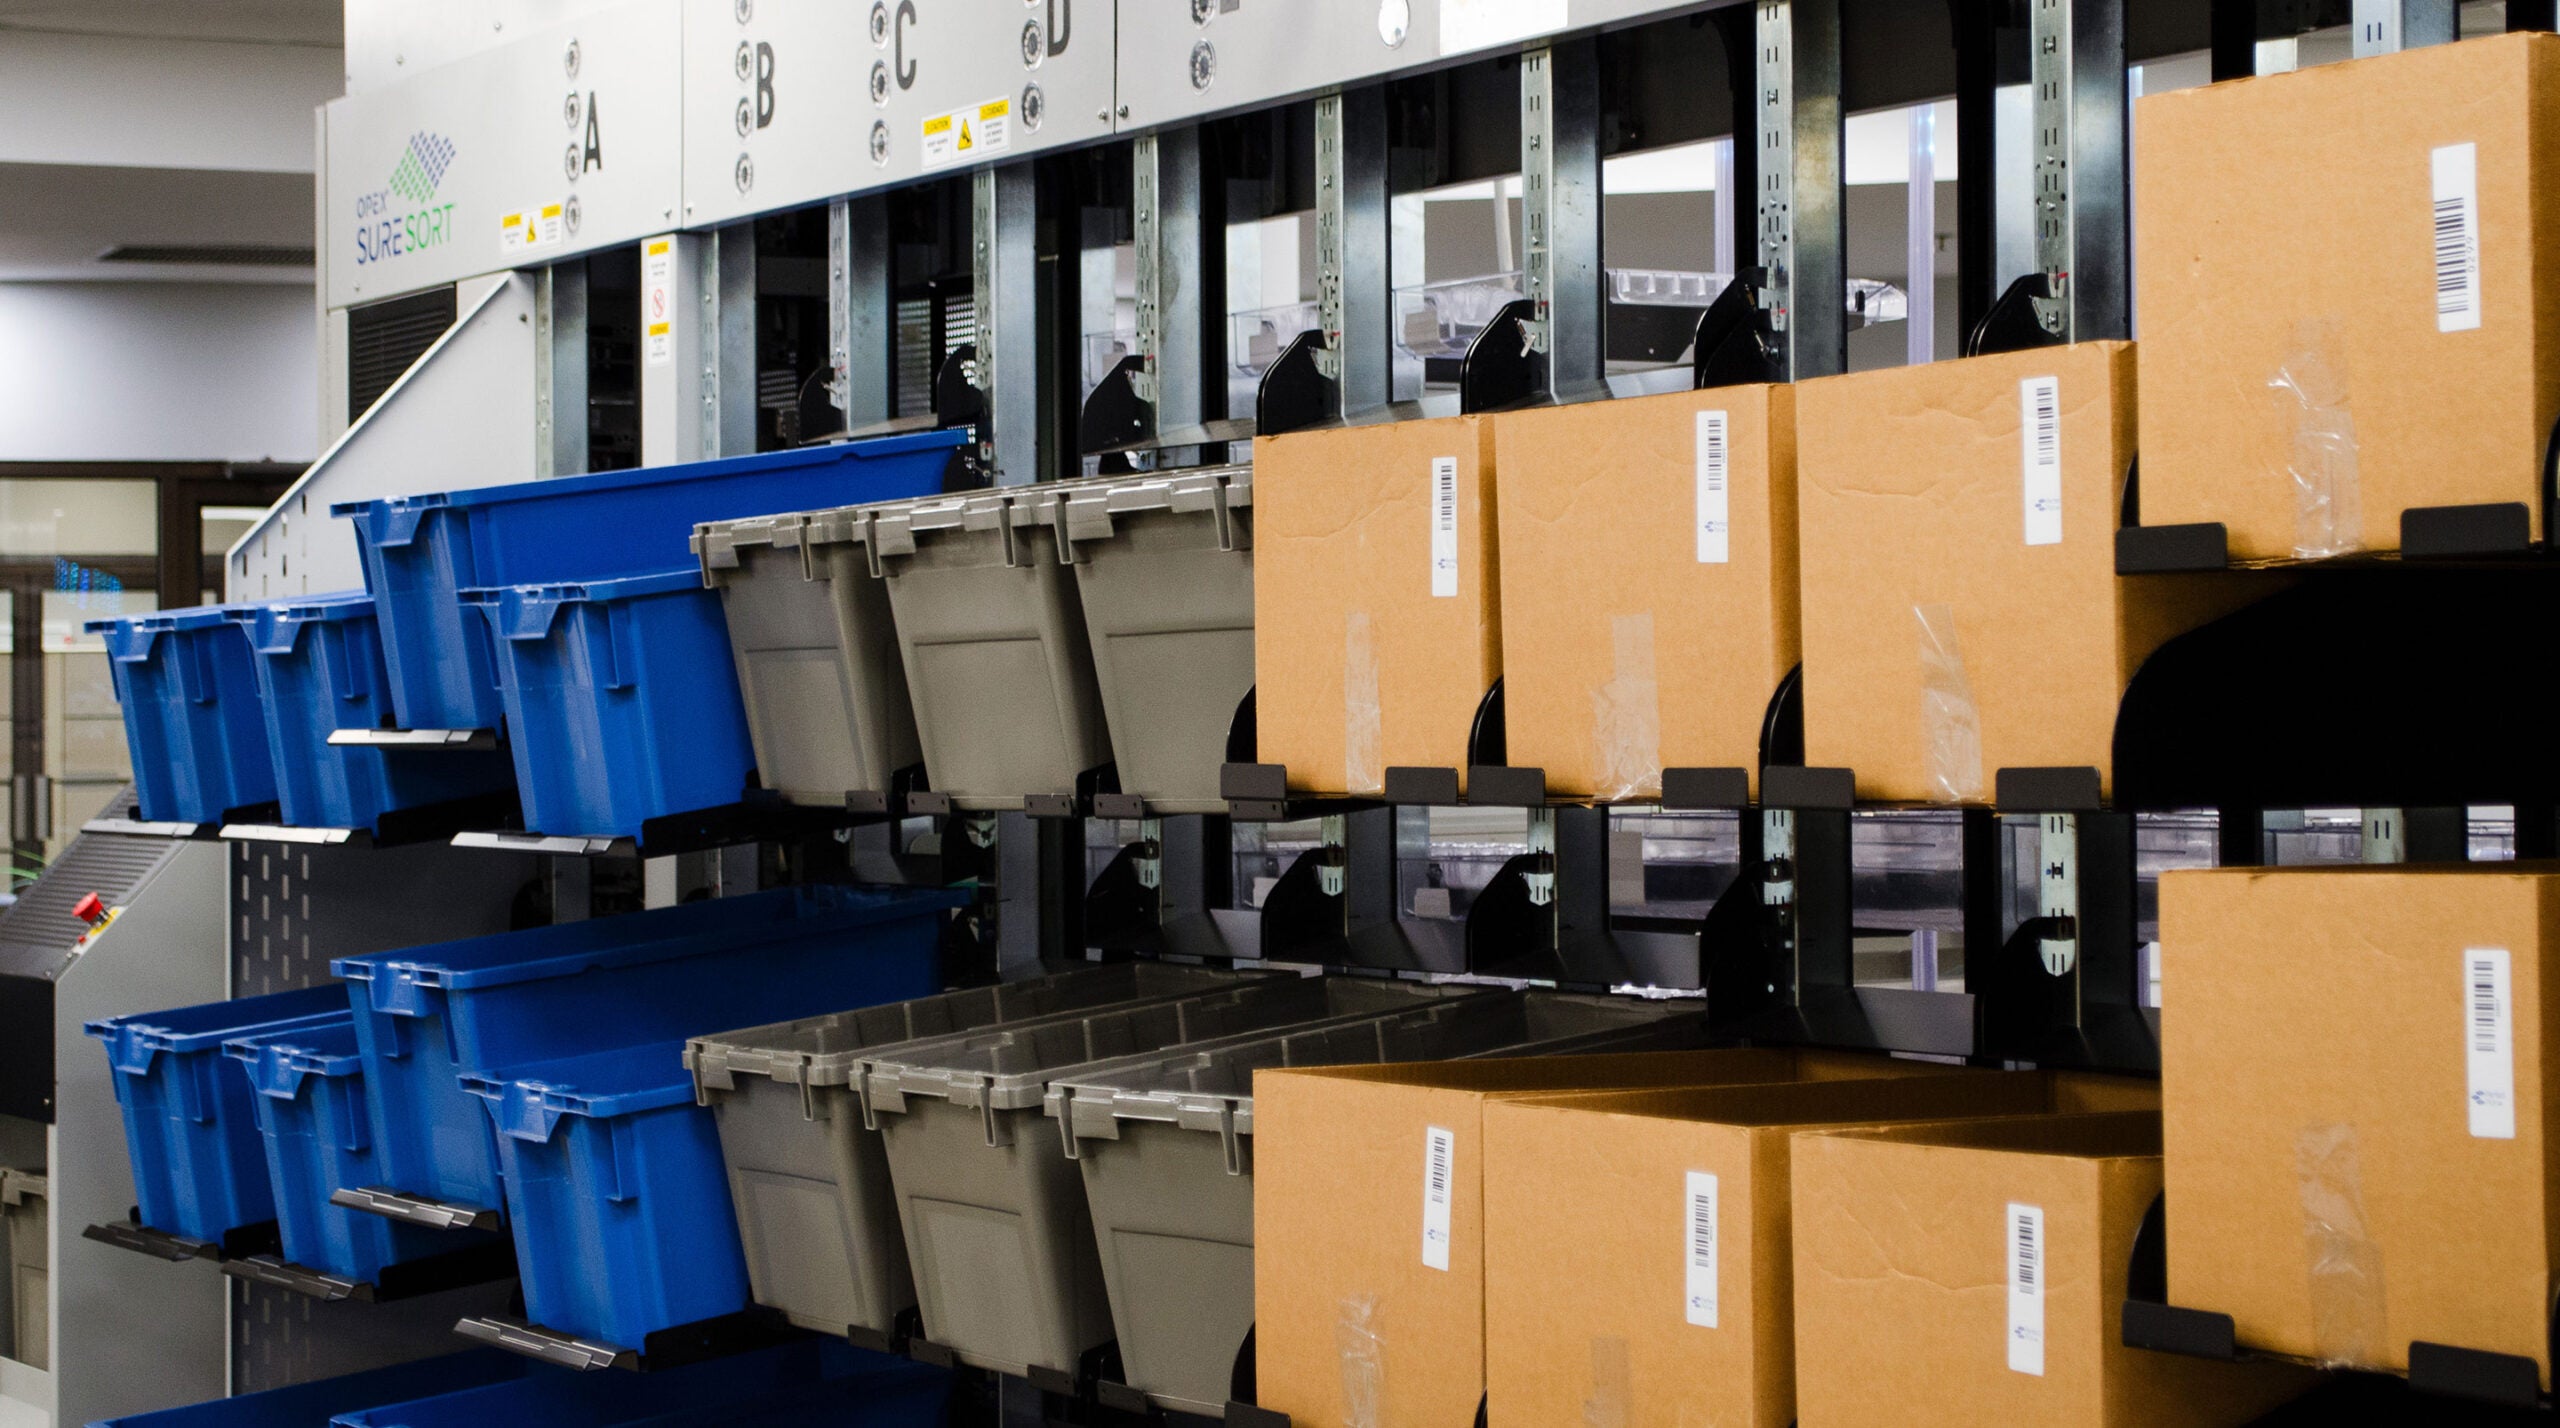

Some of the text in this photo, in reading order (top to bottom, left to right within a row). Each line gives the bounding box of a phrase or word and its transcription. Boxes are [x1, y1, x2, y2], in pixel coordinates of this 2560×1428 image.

[895, 0, 917, 91] C
[1047, 0, 1072, 58] D
[756, 41, 775, 129] B
[583, 91, 602, 173] A
[357, 193, 387, 219] OPEX
